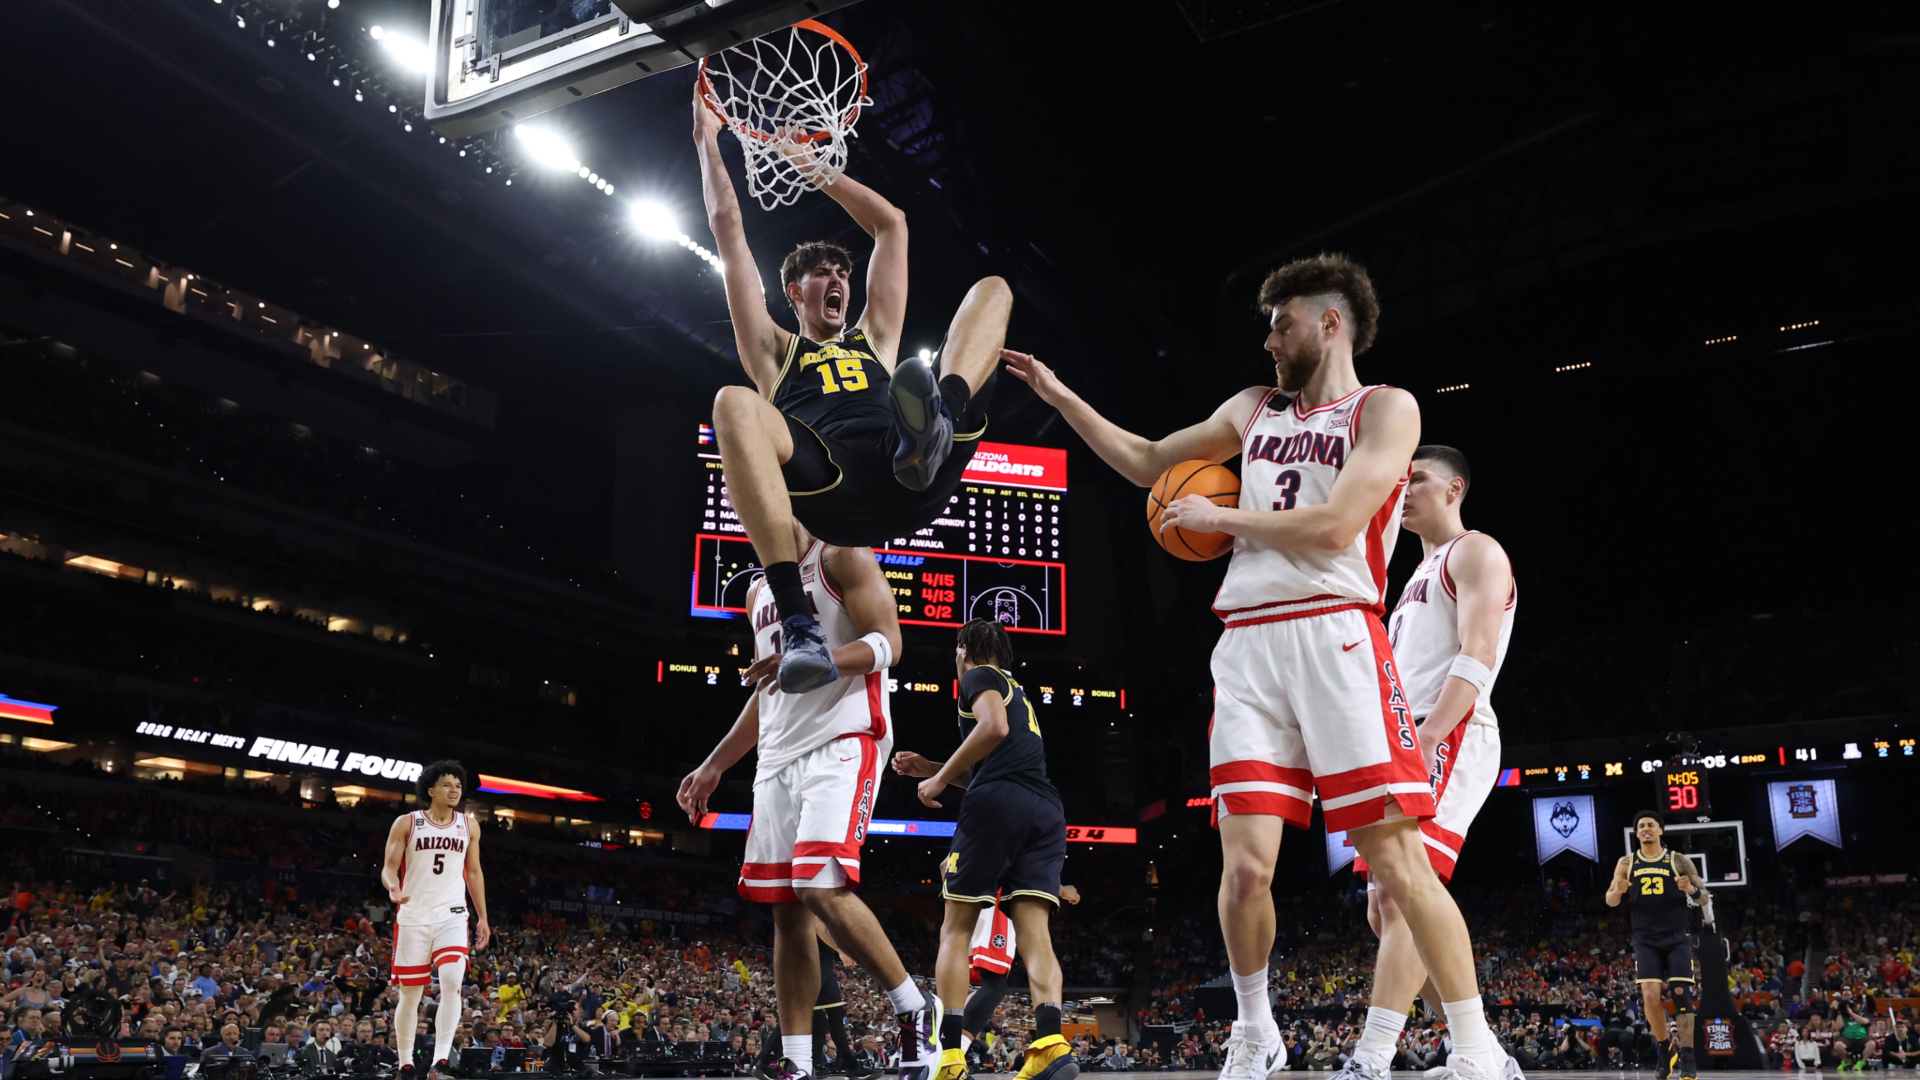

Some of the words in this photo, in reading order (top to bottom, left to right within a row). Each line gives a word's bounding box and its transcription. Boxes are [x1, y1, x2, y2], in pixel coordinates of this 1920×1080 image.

[816, 359, 869, 395] 15
[1247, 430, 1344, 472] ARIZONA
[1272, 469, 1302, 512] 3
[1051, 505, 1058, 513] 0
[1018, 513, 1026, 521] 0
[1035, 515, 1042, 523] 0
[1052, 516, 1058, 524] 2
[703, 522, 716, 530] 23
[986, 522, 992, 530] 3
[1035, 526, 1042, 534] 0
[909, 538, 945, 549] AWAKA
[969, 532, 976, 540] 9
[1002, 535, 1009, 543] 0
[1051, 539, 1059, 547] 0
[986, 545, 992, 553] 7
[1019, 548, 1026, 556] 0
[1035, 549, 1042, 557] 0
[884, 554, 925, 566] HALF
[922, 573, 954, 587] 4/15
[922, 588, 955, 603] 4/13
[924, 604, 952, 619] 0/2
[670, 664, 697, 672] BONUS
[705, 666, 720, 674] FLS
[707, 673, 718, 684] 2
[914, 683, 939, 692] 2ND
[1043, 693, 1051, 703] 2
[1073, 695, 1081, 705] 2
[1383, 661, 1416, 750] CATS
[136, 721, 173, 738] 2026
[209, 732, 246, 750] MEN'S
[248, 735, 340, 772] FINAL
[341, 751, 424, 783] FOUR
[1796, 748, 1816, 761] 41
[1879, 748, 1888, 757] 2
[1904, 746, 1913, 755] 2
[1738, 754, 1766, 764] 2ND
[1579, 770, 1589, 779] 2
[1605, 763, 1623, 776] M
[1556, 772, 1565, 781] 2
[1668, 771, 1699, 786] 14:05
[1669, 785, 1697, 809] 30
[1791, 790, 1814, 799] FINAL
[854, 779, 872, 842] CATS
[1793, 804, 1815, 813] FOUR
[415, 836, 464, 853] ARIZONA
[432, 853, 446, 875] 5
[1640, 876, 1665, 896] 23
[1706, 1025, 1731, 1034] FINAL
[1709, 1041, 1733, 1050] FOUR
